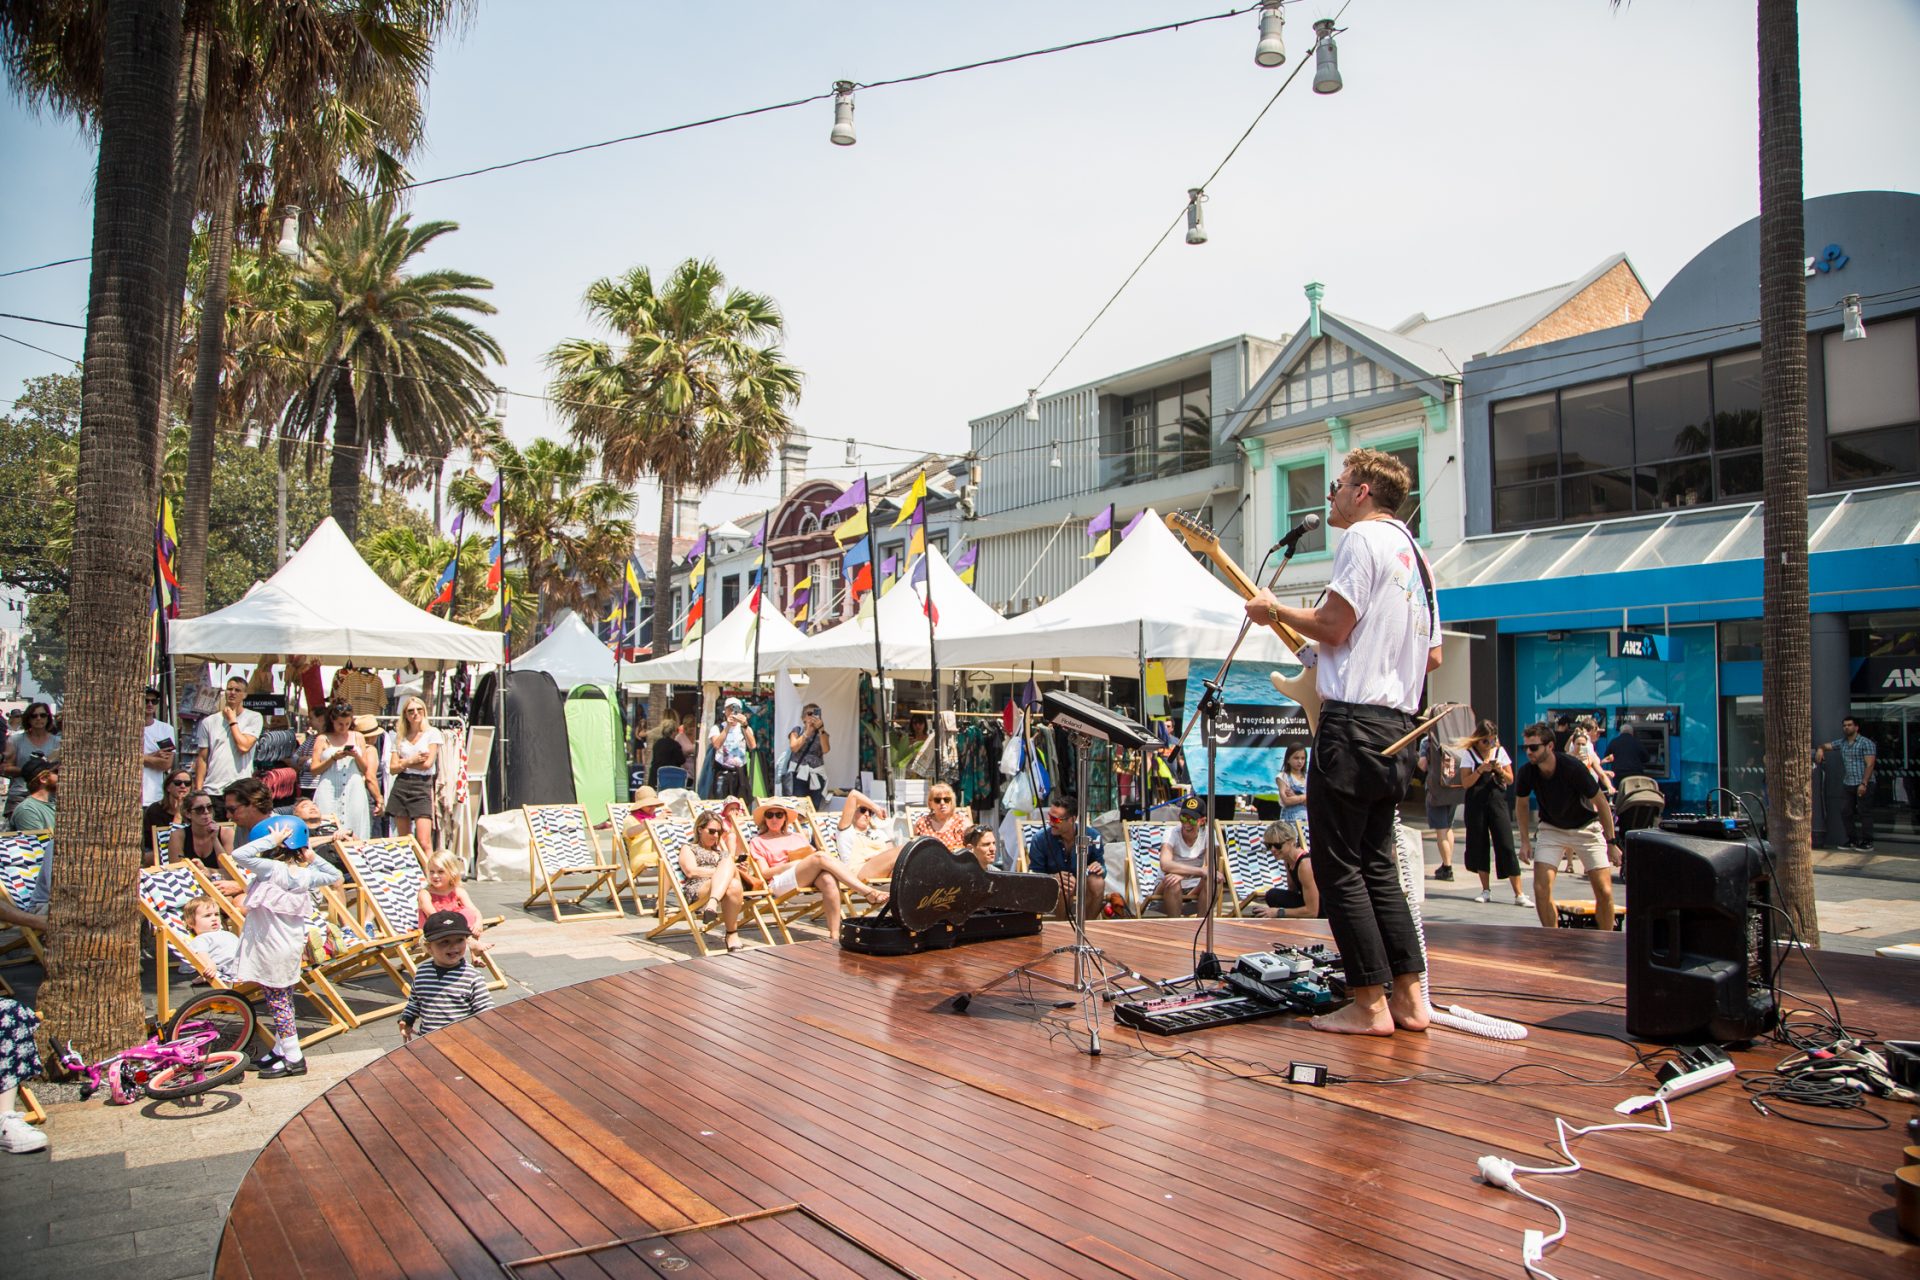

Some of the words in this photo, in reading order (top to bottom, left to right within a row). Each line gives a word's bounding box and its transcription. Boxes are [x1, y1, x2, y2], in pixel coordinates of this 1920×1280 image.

[1622, 640, 1642, 656] ANZ
[1242, 716, 1275, 725] recycled
[1646, 712, 1665, 721] ANZ
[1061, 717, 1083, 729] Roland
[1247, 727, 1275, 736] plastic
